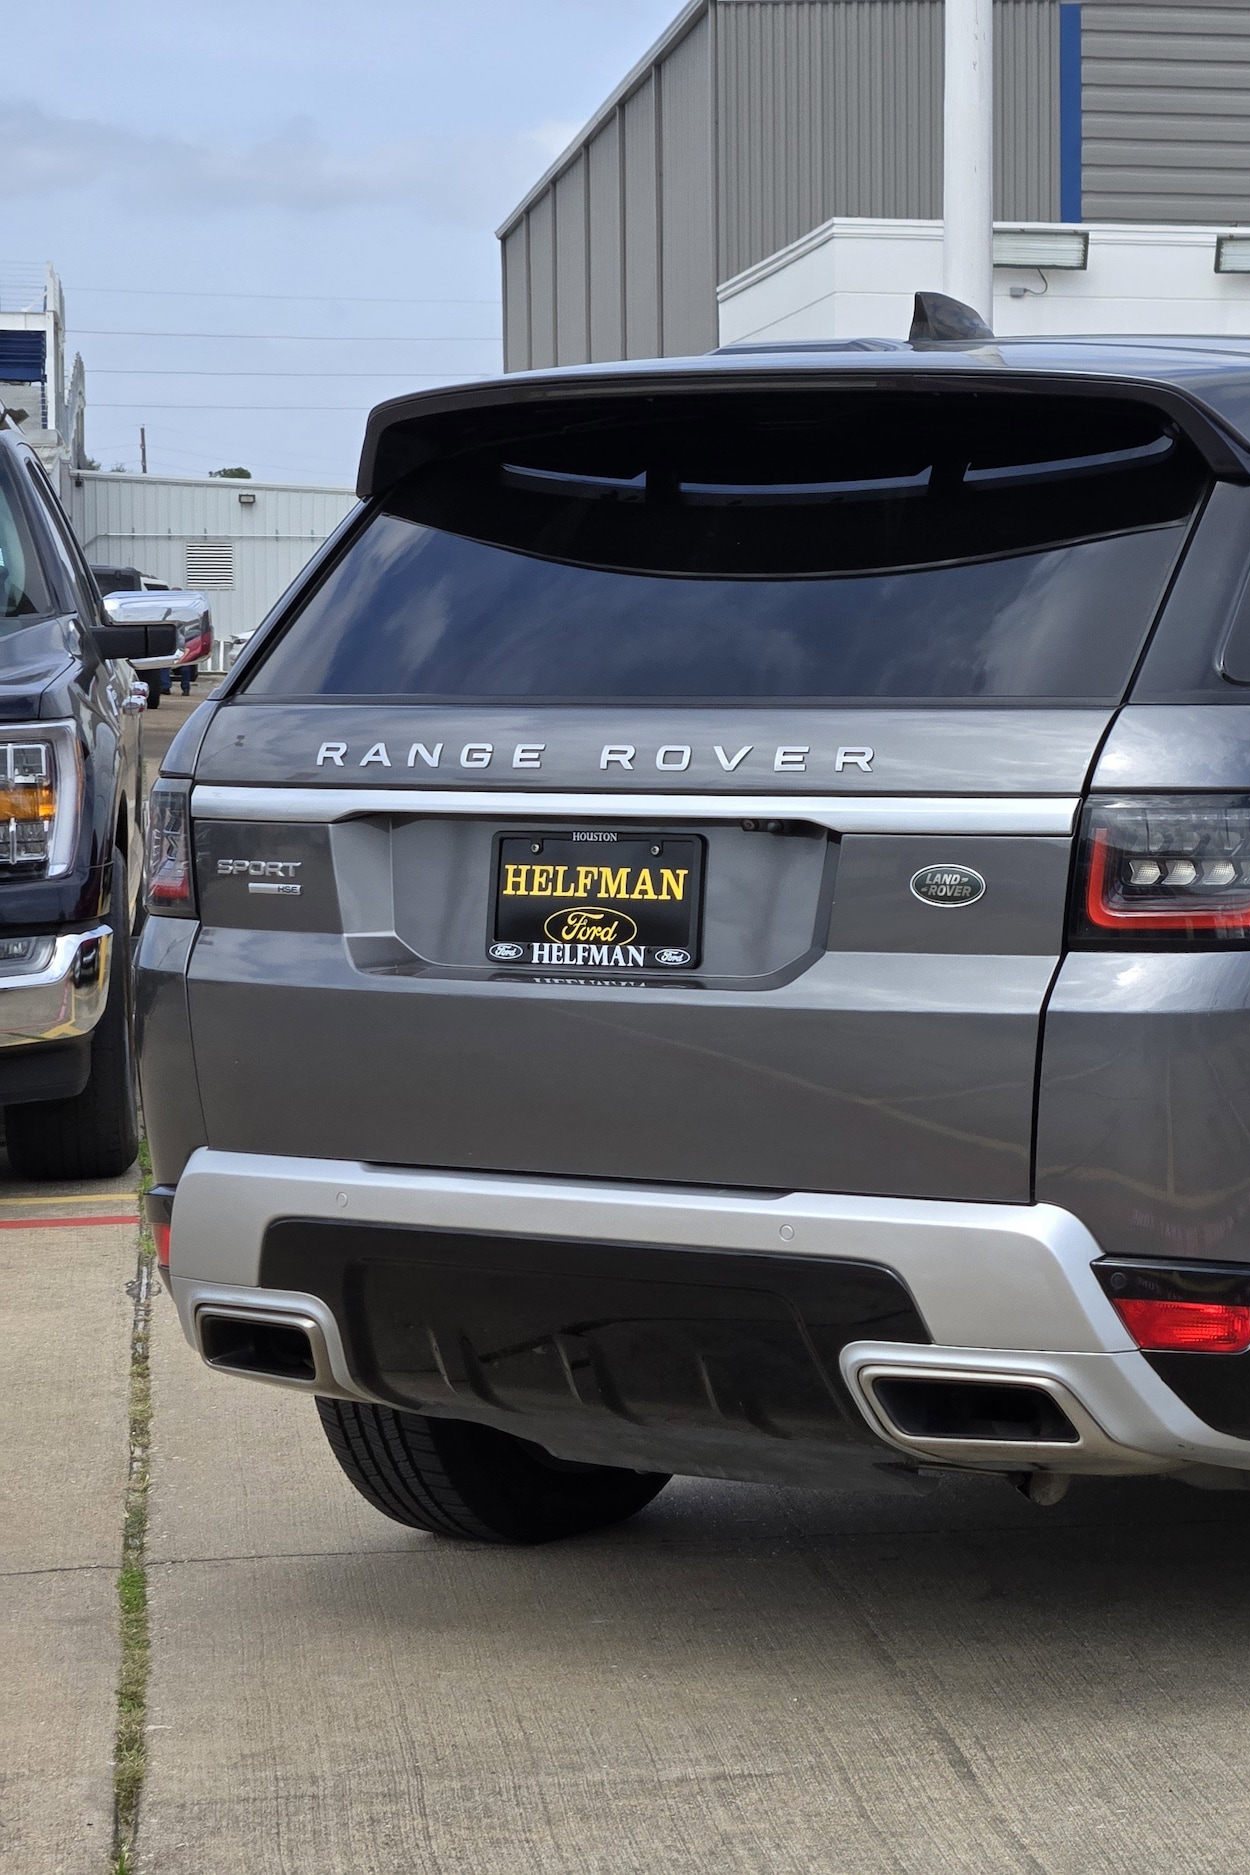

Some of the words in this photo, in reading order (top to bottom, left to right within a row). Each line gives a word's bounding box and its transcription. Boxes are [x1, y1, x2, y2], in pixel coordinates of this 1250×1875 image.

[316, 742, 547, 769] RANGE
[600, 744, 875, 772] ROVER
[572, 831, 618, 842] HOUSTON
[217, 859, 302, 877] SPORT
[502, 864, 689, 901] HELFMAN
[925, 873, 961, 885] LAND
[277, 885, 298, 894] HSE
[927, 885, 972, 897] ROVER
[560, 911, 619, 942] Ford
[530, 942, 648, 967] HELFMAN
